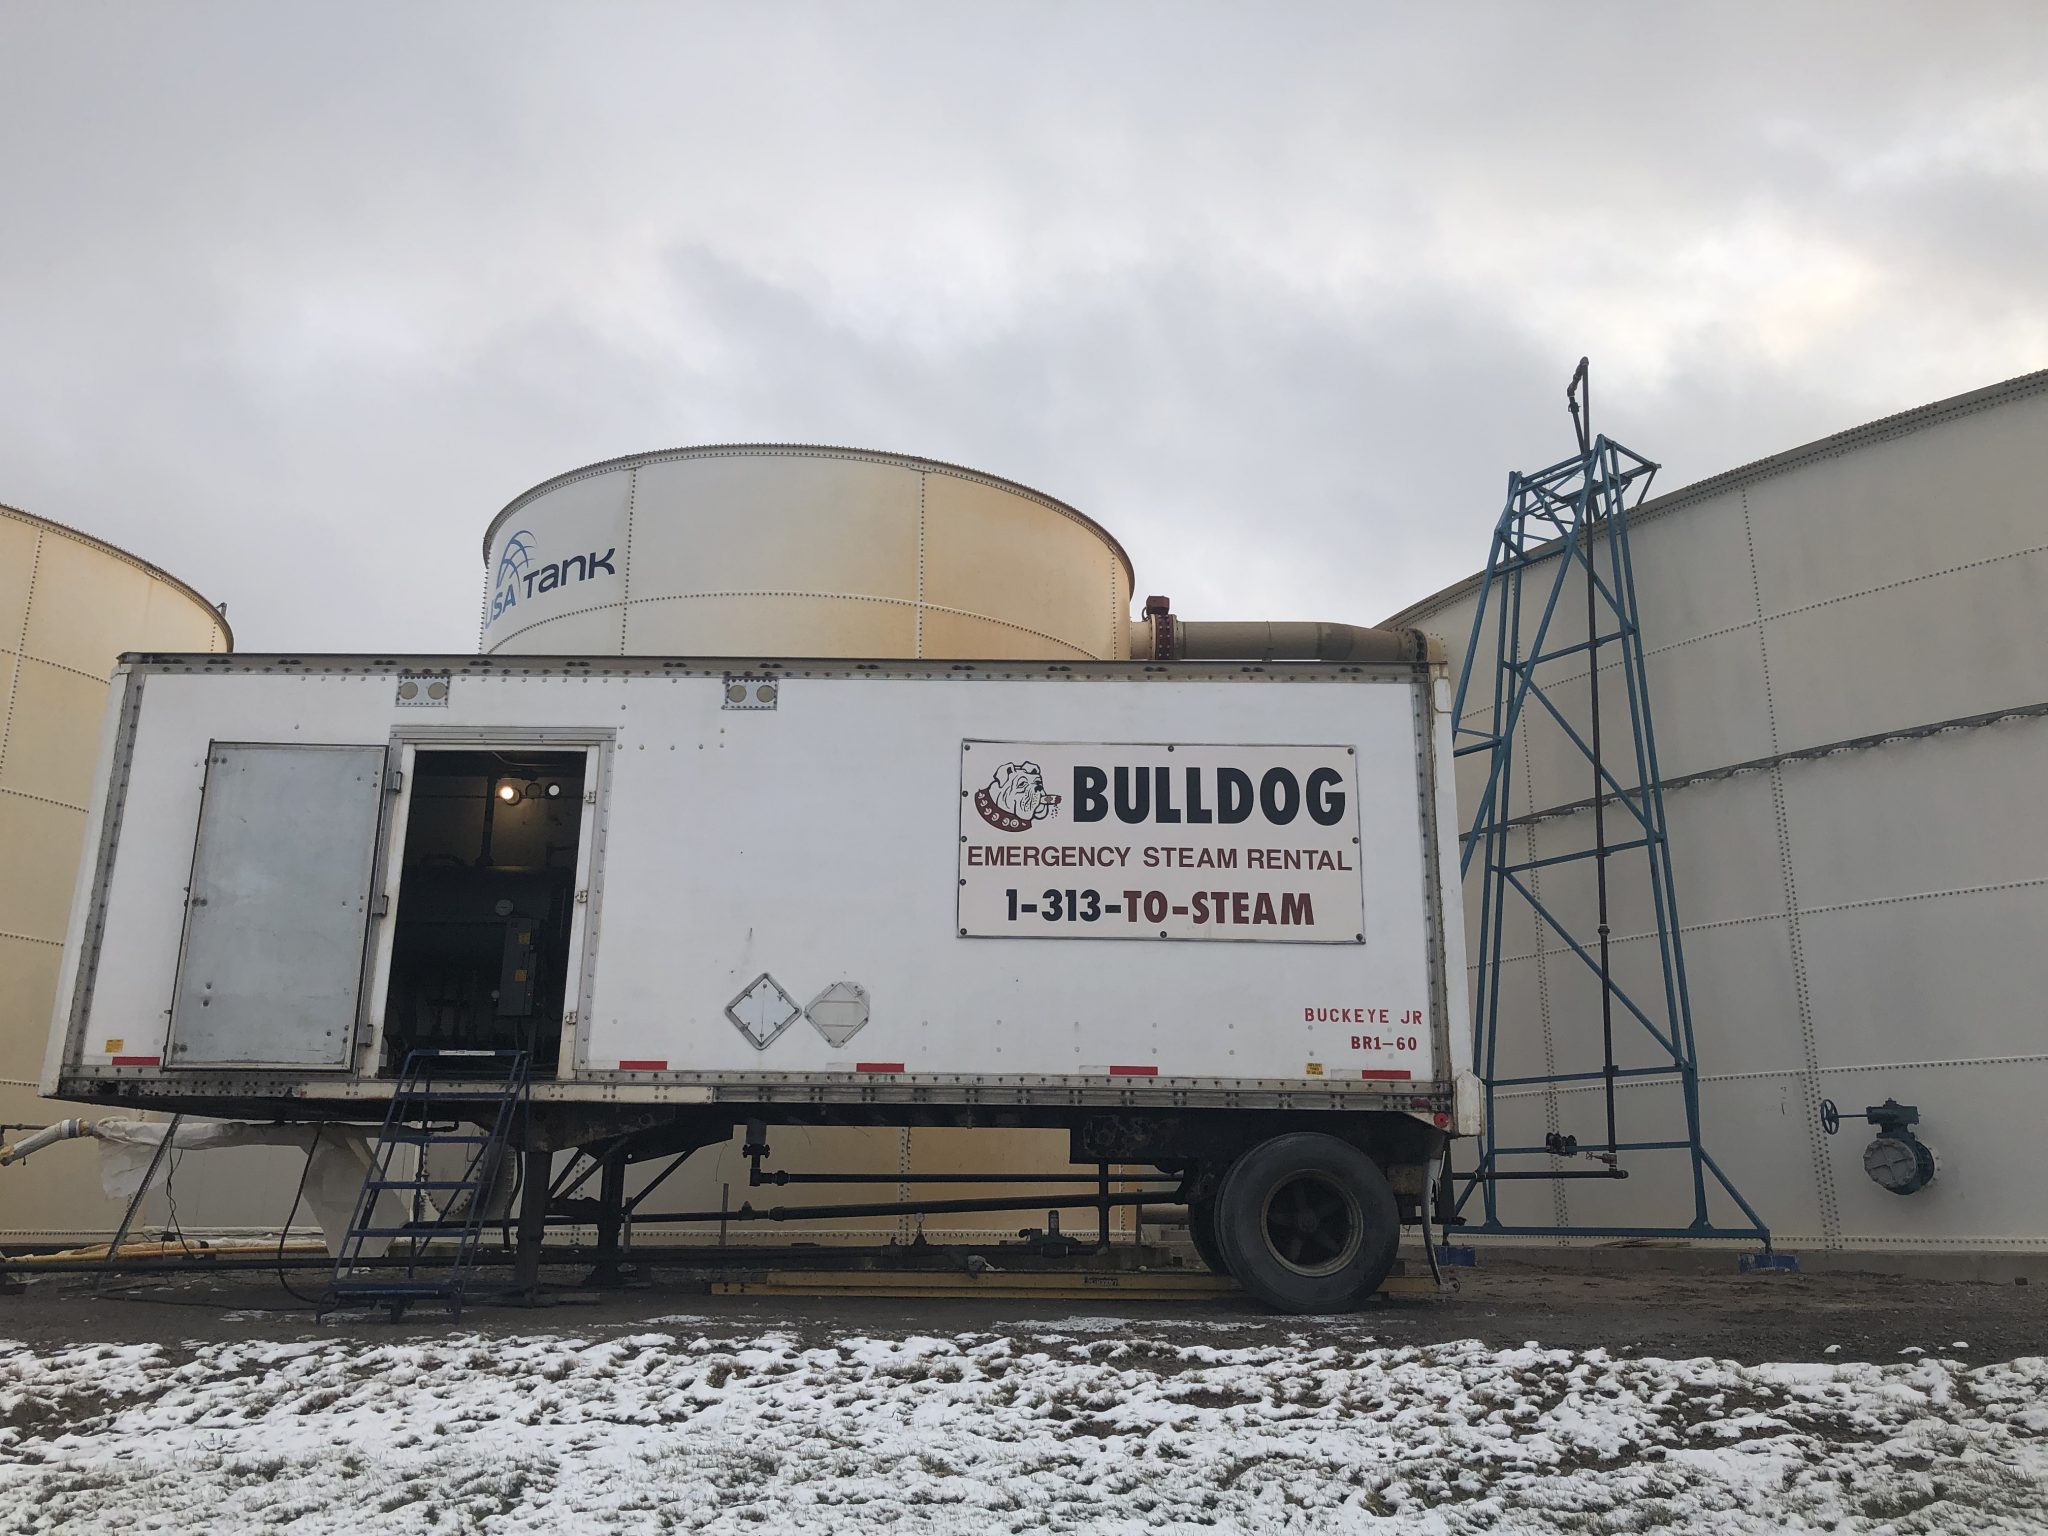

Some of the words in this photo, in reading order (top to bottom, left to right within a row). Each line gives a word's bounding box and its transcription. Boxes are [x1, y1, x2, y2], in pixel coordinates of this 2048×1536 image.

[485, 584, 517, 630] USA
[1073, 765, 1346, 826] BULLDOG
[967, 846, 1131, 868] EMERGENCY
[1143, 846, 1238, 869] STEAM
[1247, 848, 1353, 871] RENTAL
[1005, 888, 1315, 926] 1-313-TO-STEAM
[1304, 1007, 1389, 1024] BUCKEYE
[1400, 1010, 1423, 1025] JR
